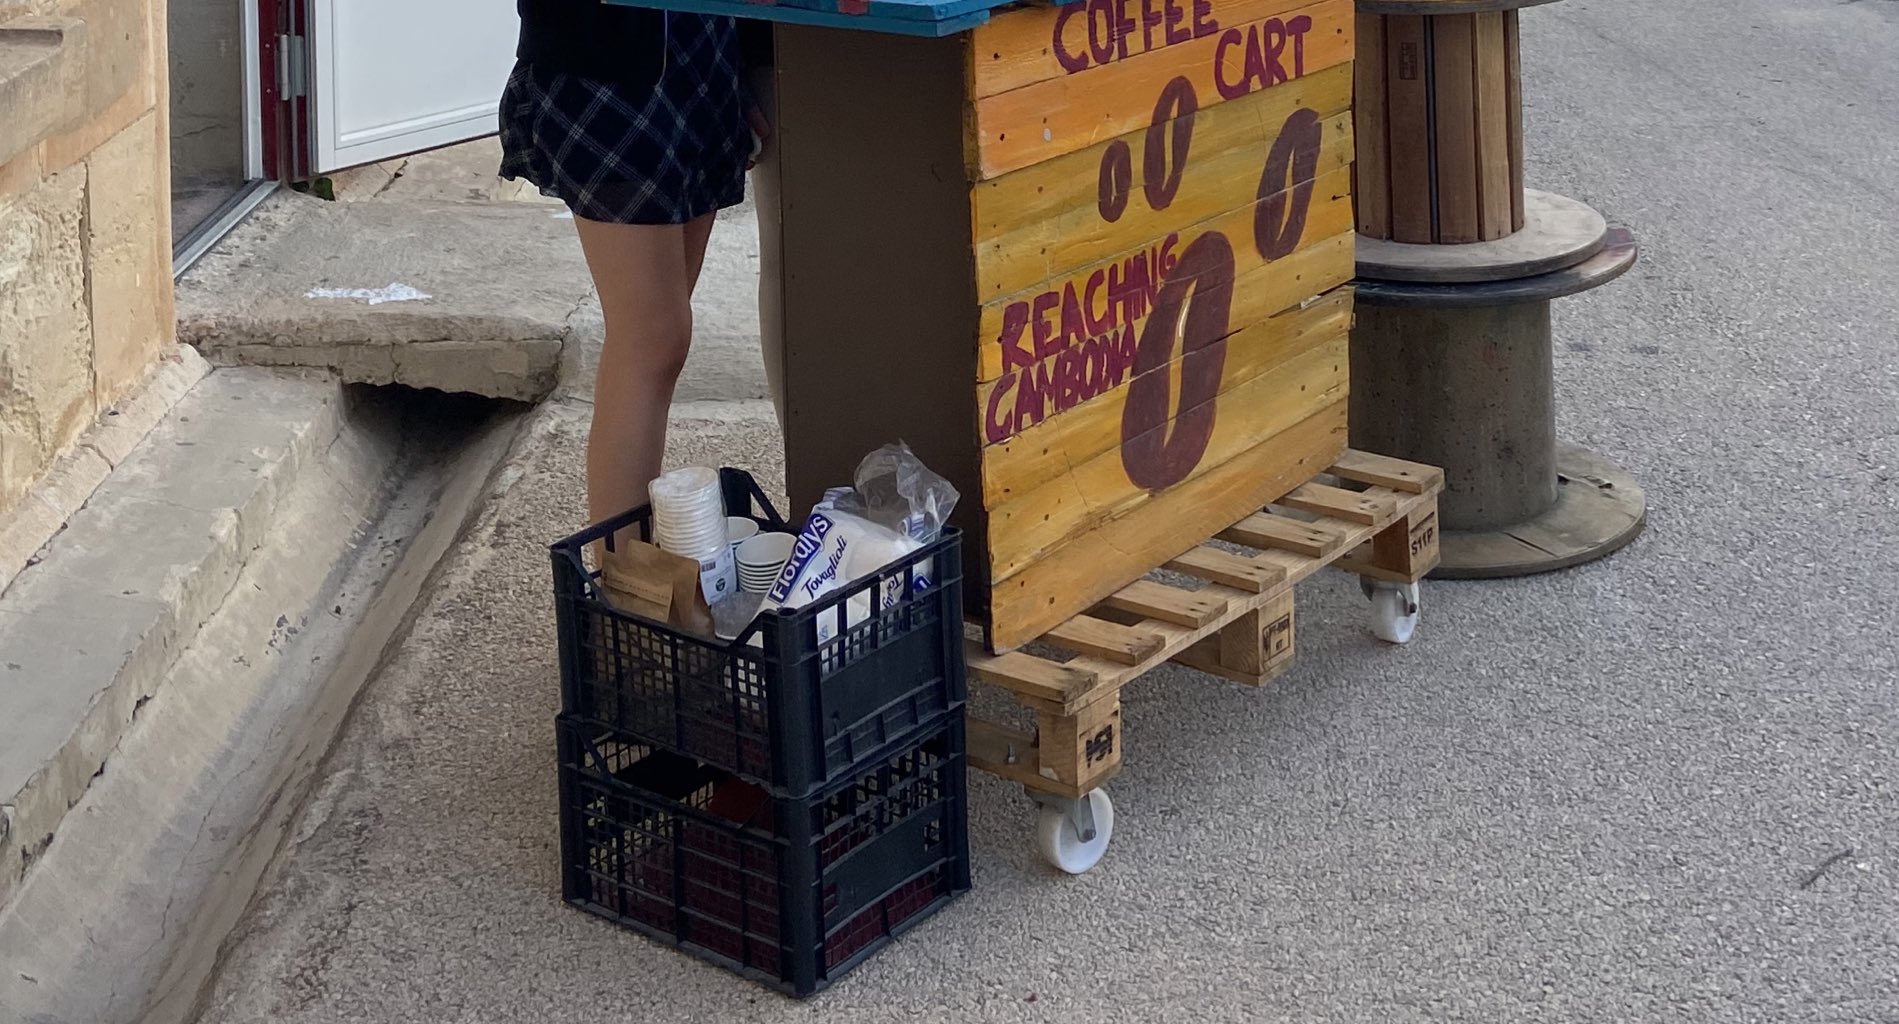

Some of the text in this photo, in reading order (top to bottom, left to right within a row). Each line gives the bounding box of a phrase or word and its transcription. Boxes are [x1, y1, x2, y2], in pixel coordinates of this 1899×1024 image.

[1214, 15, 1312, 101] CART
[1001, 232, 1179, 373] REACHING
[801, 535, 847, 600] Tovaglioli
